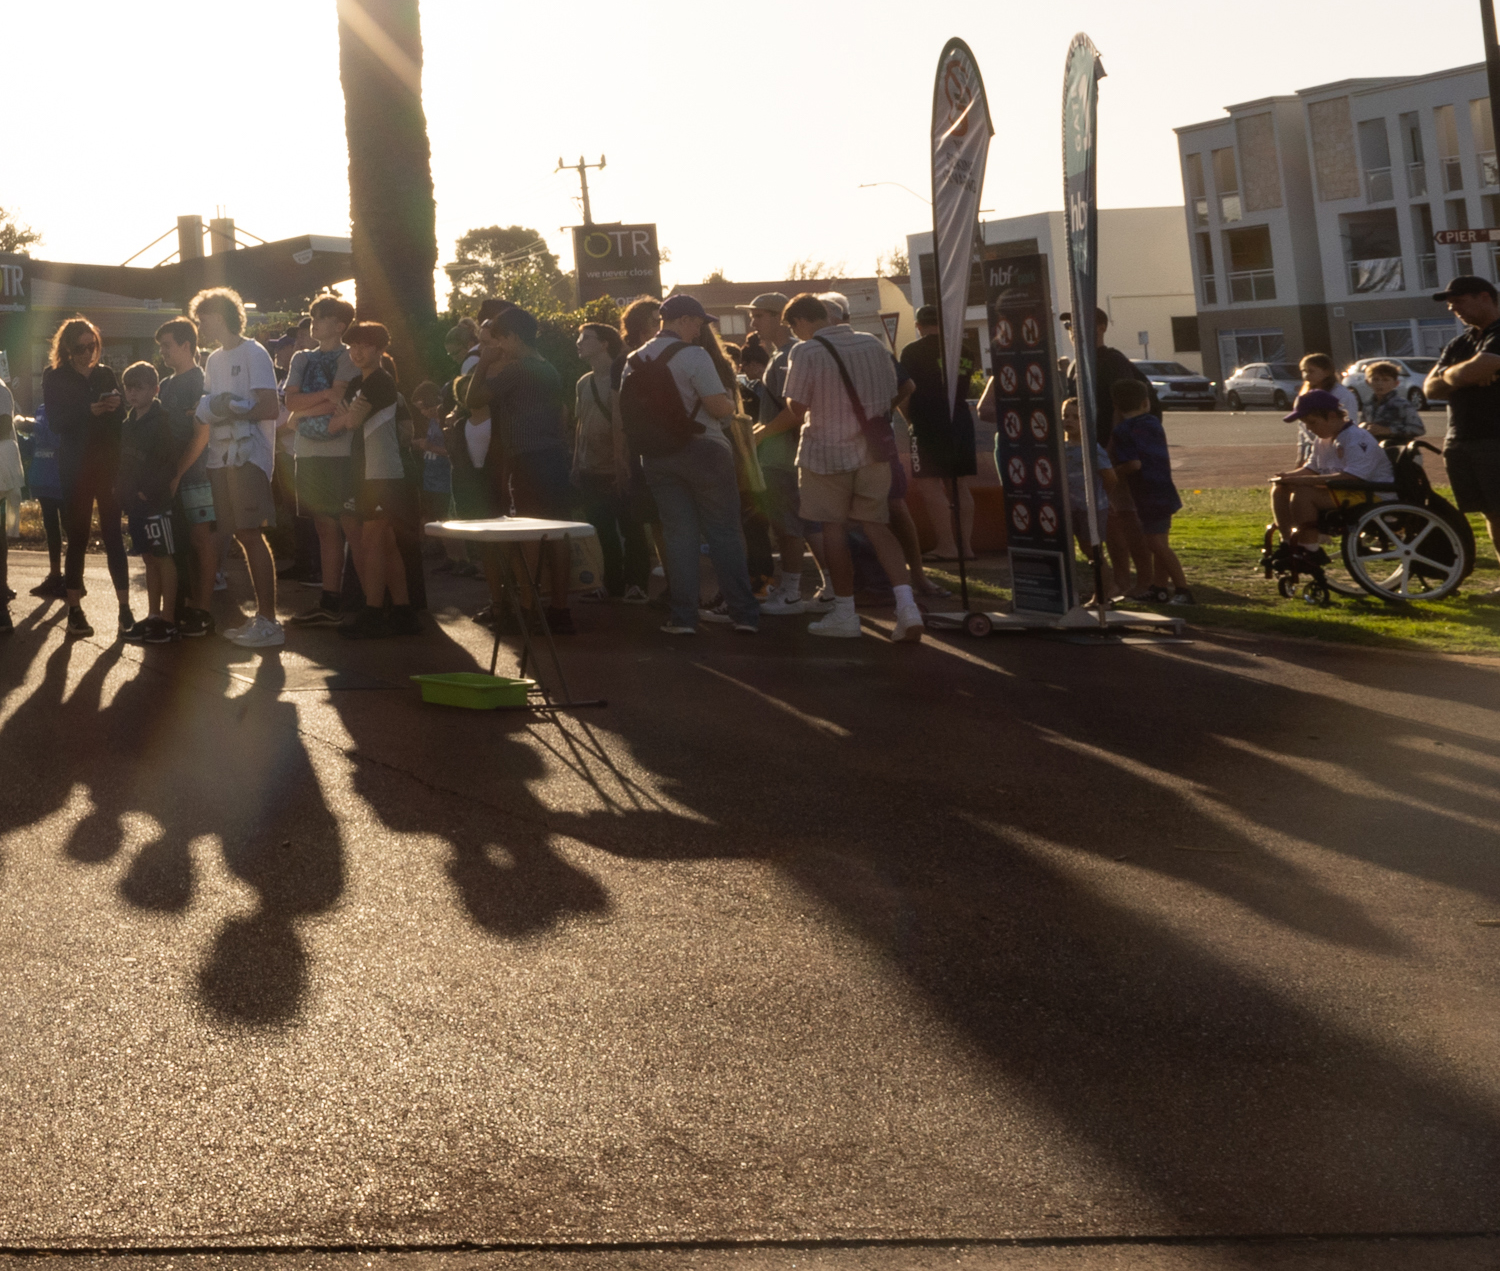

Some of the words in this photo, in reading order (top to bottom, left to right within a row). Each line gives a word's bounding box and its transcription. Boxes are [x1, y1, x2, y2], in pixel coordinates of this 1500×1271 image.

[1070, 193, 1089, 234] hb
[584, 230, 651, 259] OTR
[1446, 231, 1477, 242] PIER
[629, 268, 653, 276] close
[990, 265, 1014, 287] hbf
[144, 522, 161, 539] 10
